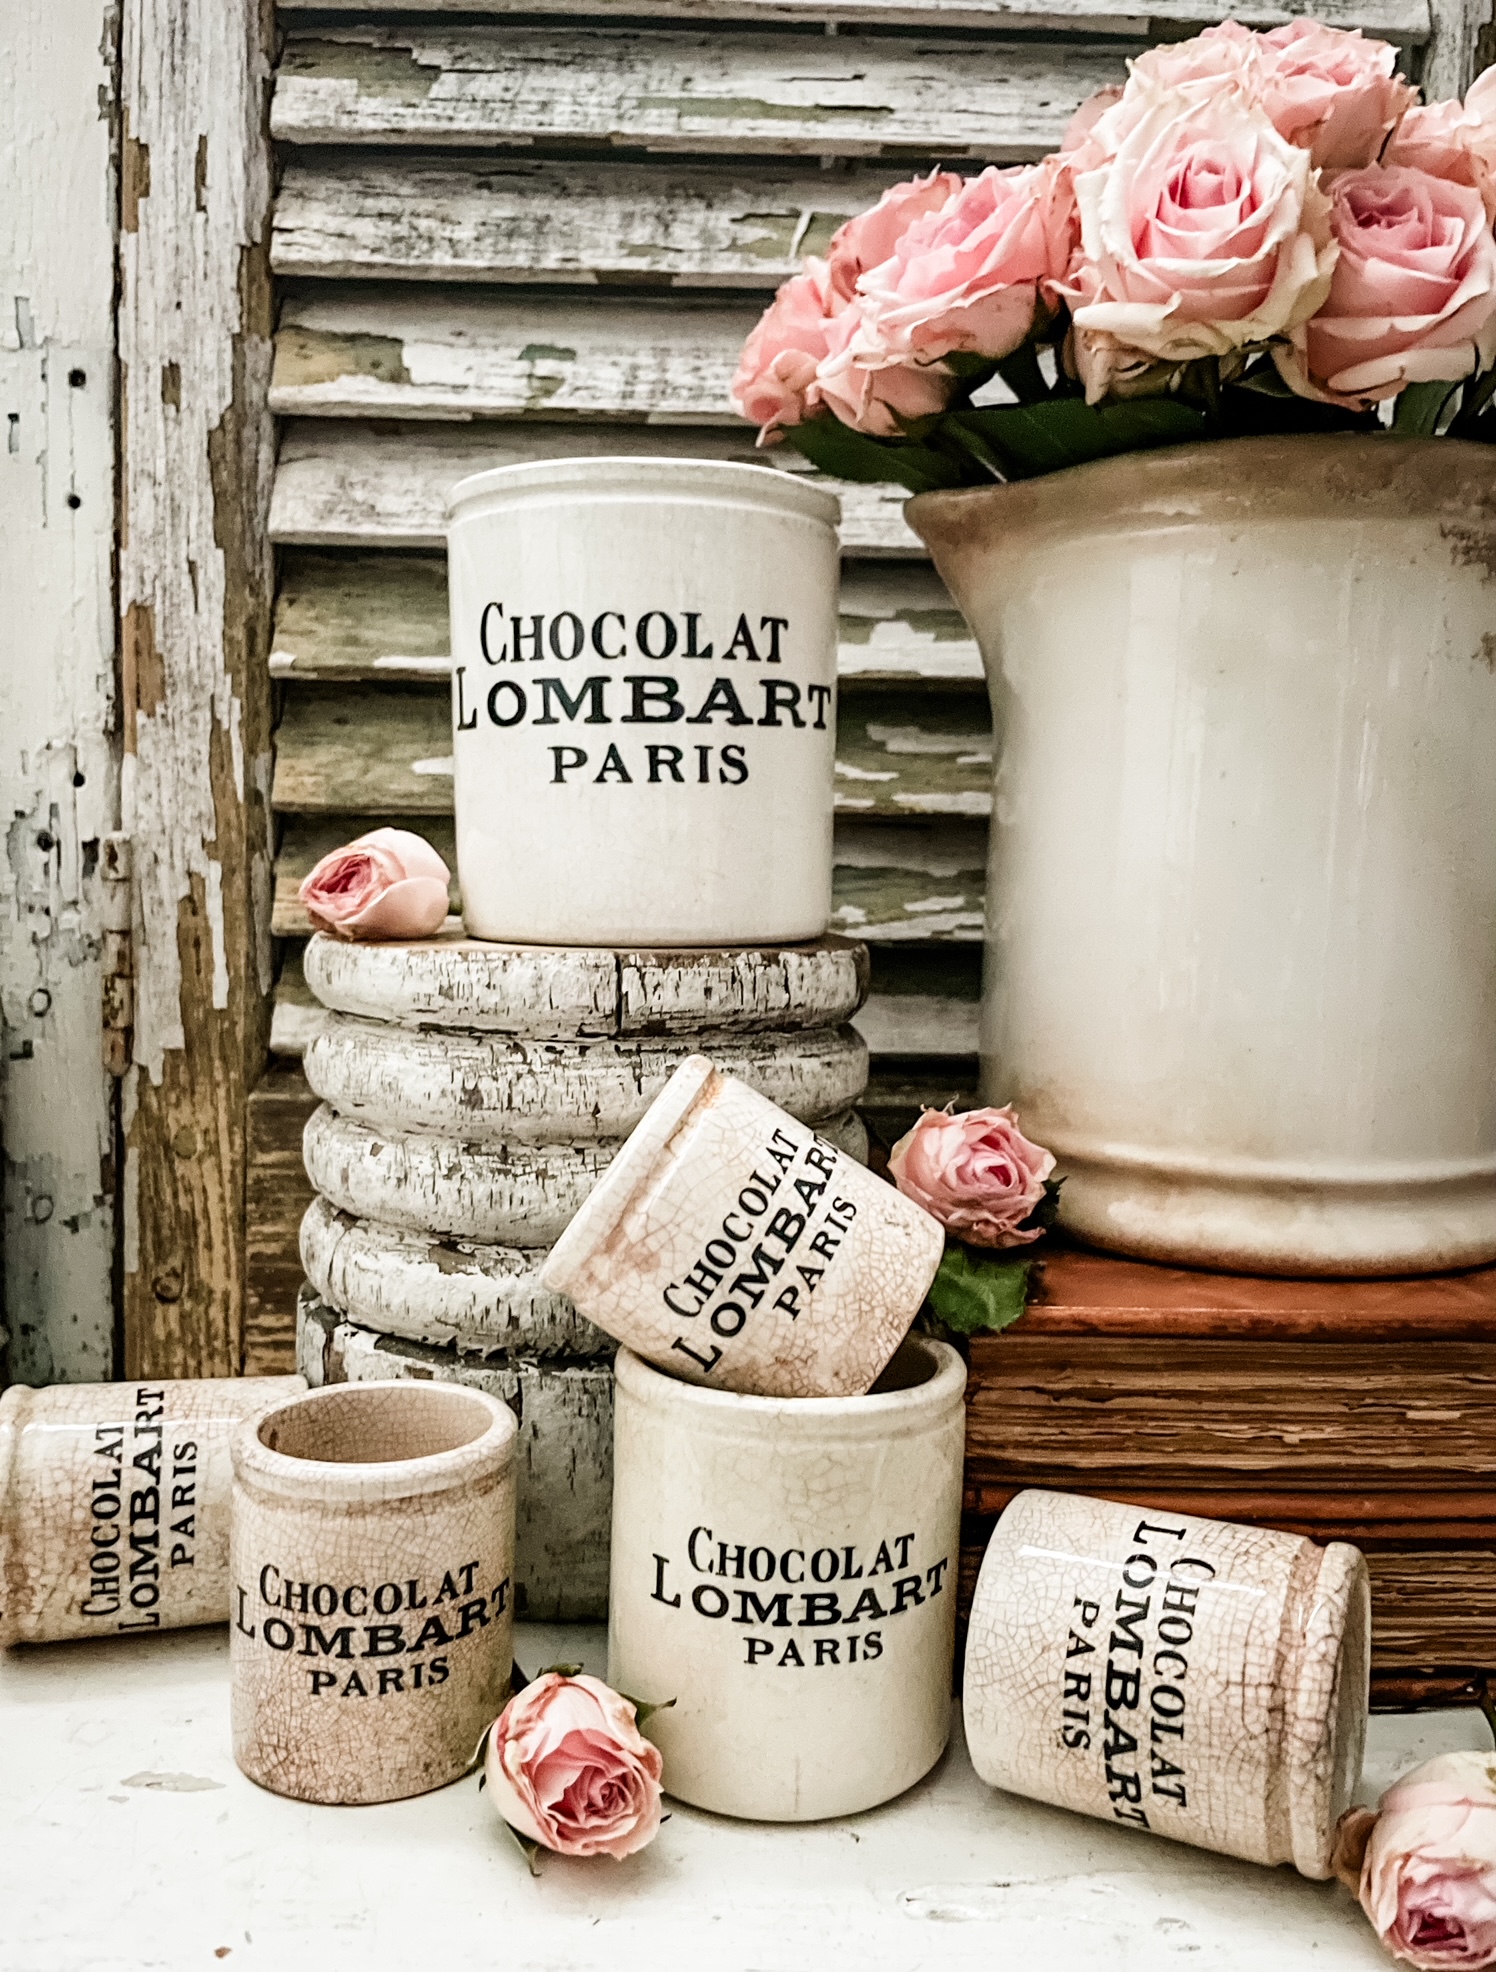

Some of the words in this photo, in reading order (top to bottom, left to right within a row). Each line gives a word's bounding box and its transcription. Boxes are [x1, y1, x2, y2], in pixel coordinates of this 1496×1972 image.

[480, 602, 789, 665] CHOCOLAT
[456, 667, 832, 731] LOMBART
[547, 743, 750, 785] PARIS
[663, 1128, 800, 1318] CHOCOLAT
[772, 1196, 858, 1321] PARIS
[80, 1422, 125, 1617] CHOCOLAT
[118, 1388, 165, 1630] LOMBART
[170, 1440, 199, 1569] PARIS
[259, 1563, 480, 1617] CHOCOLAT
[650, 1557, 948, 1627] LOMBART
[687, 1526, 915, 1584] CHOCOLAT
[236, 1576, 510, 1659] LOMBART
[743, 1631, 884, 1667] PARIS
[307, 1656, 450, 1698] PARIS
[1061, 1595, 1100, 1751] PARIS
[1103, 1520, 1187, 1829] LOMBART
[1150, 1558, 1217, 1808] CHOCOLAT
